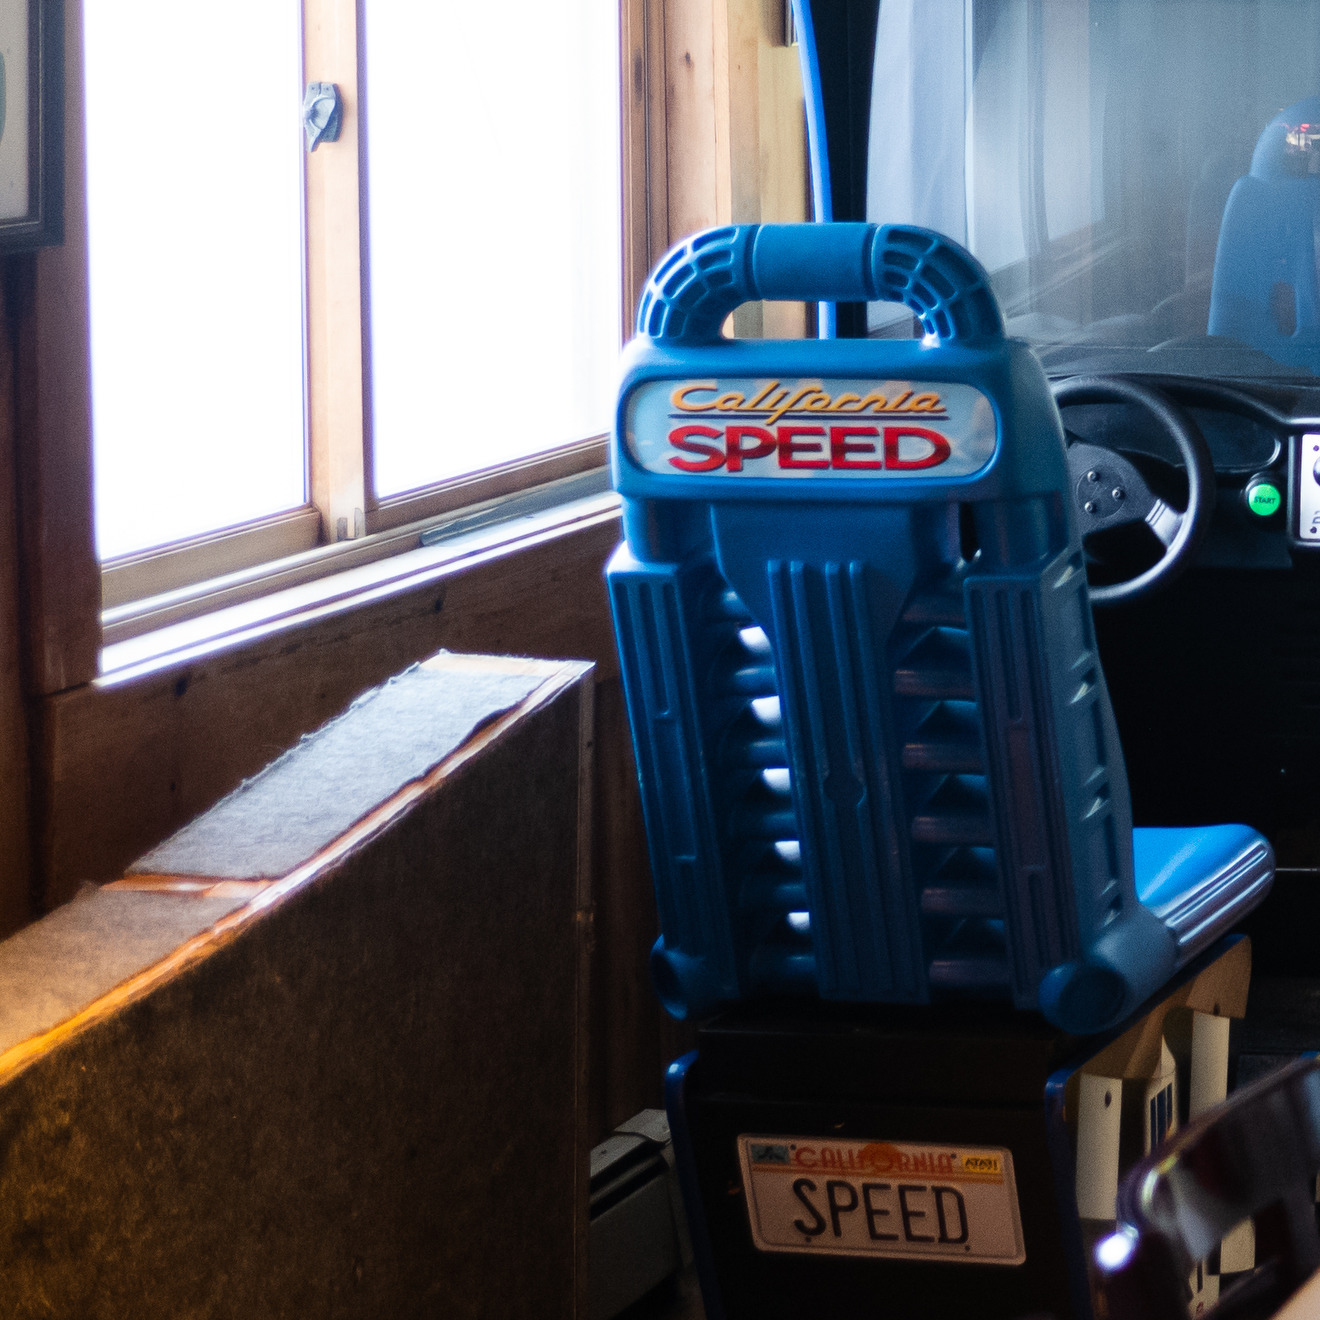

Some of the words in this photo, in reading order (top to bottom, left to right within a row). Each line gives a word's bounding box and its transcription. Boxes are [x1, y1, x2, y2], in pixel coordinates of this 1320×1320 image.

[671, 380, 946, 425] California
[668, 425, 951, 472] SPEED
[1253, 496, 1276, 505] START
[795, 1146, 954, 1174] CALIFORNIA
[964, 1157, 998, 1172] ATARI
[793, 1177, 969, 1245] SPEED
